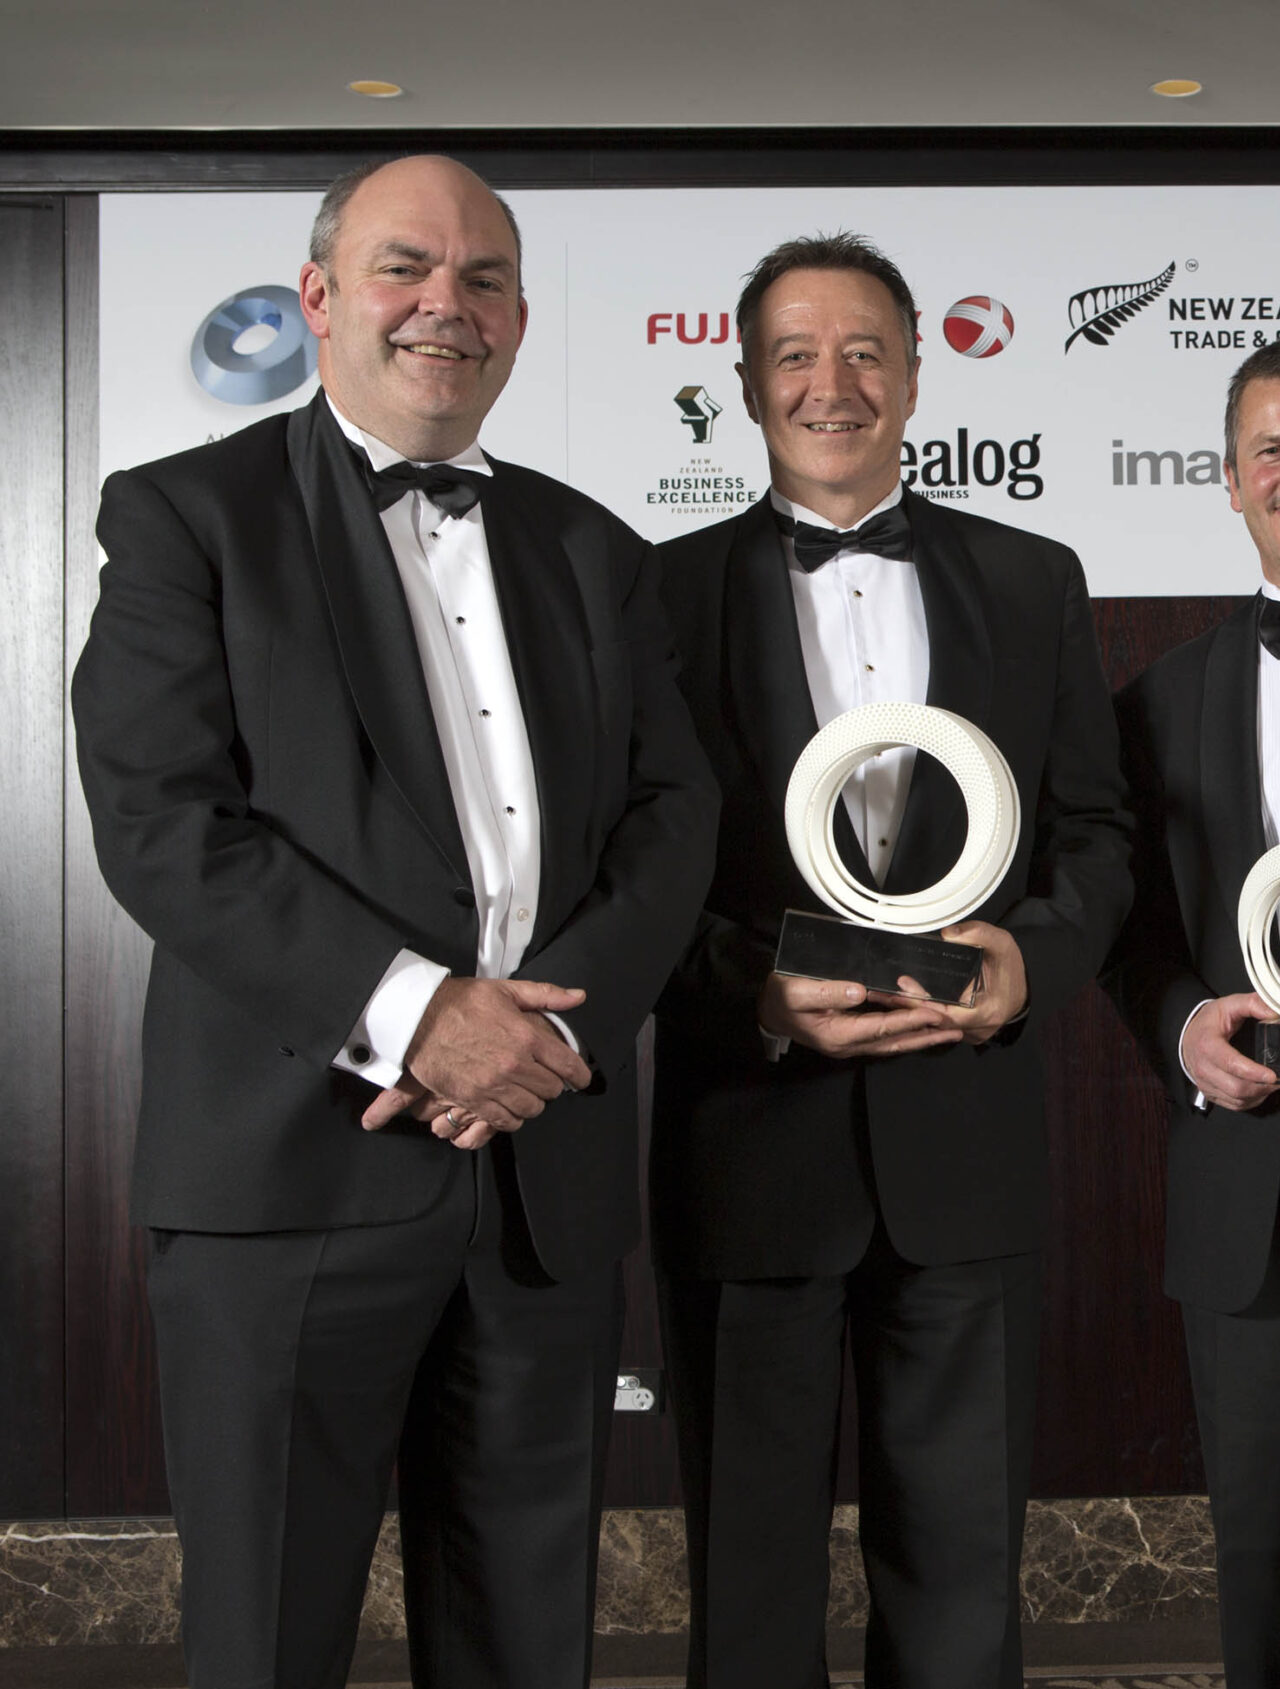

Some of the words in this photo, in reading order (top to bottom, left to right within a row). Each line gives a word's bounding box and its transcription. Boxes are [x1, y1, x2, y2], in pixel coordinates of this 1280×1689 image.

[1168, 297, 1235, 321] NEW
[1170, 330, 1246, 349] TRADE
[1252, 329, 1268, 348] &
[679, 466, 724, 474] ZEALAND
[900, 427, 1042, 501] ealog
[1112, 439, 1231, 495] ima
[659, 477, 745, 490] BUSINESS
[646, 491, 758, 504] EXCELLENCE
[671, 506, 734, 514] FOUNDATION
